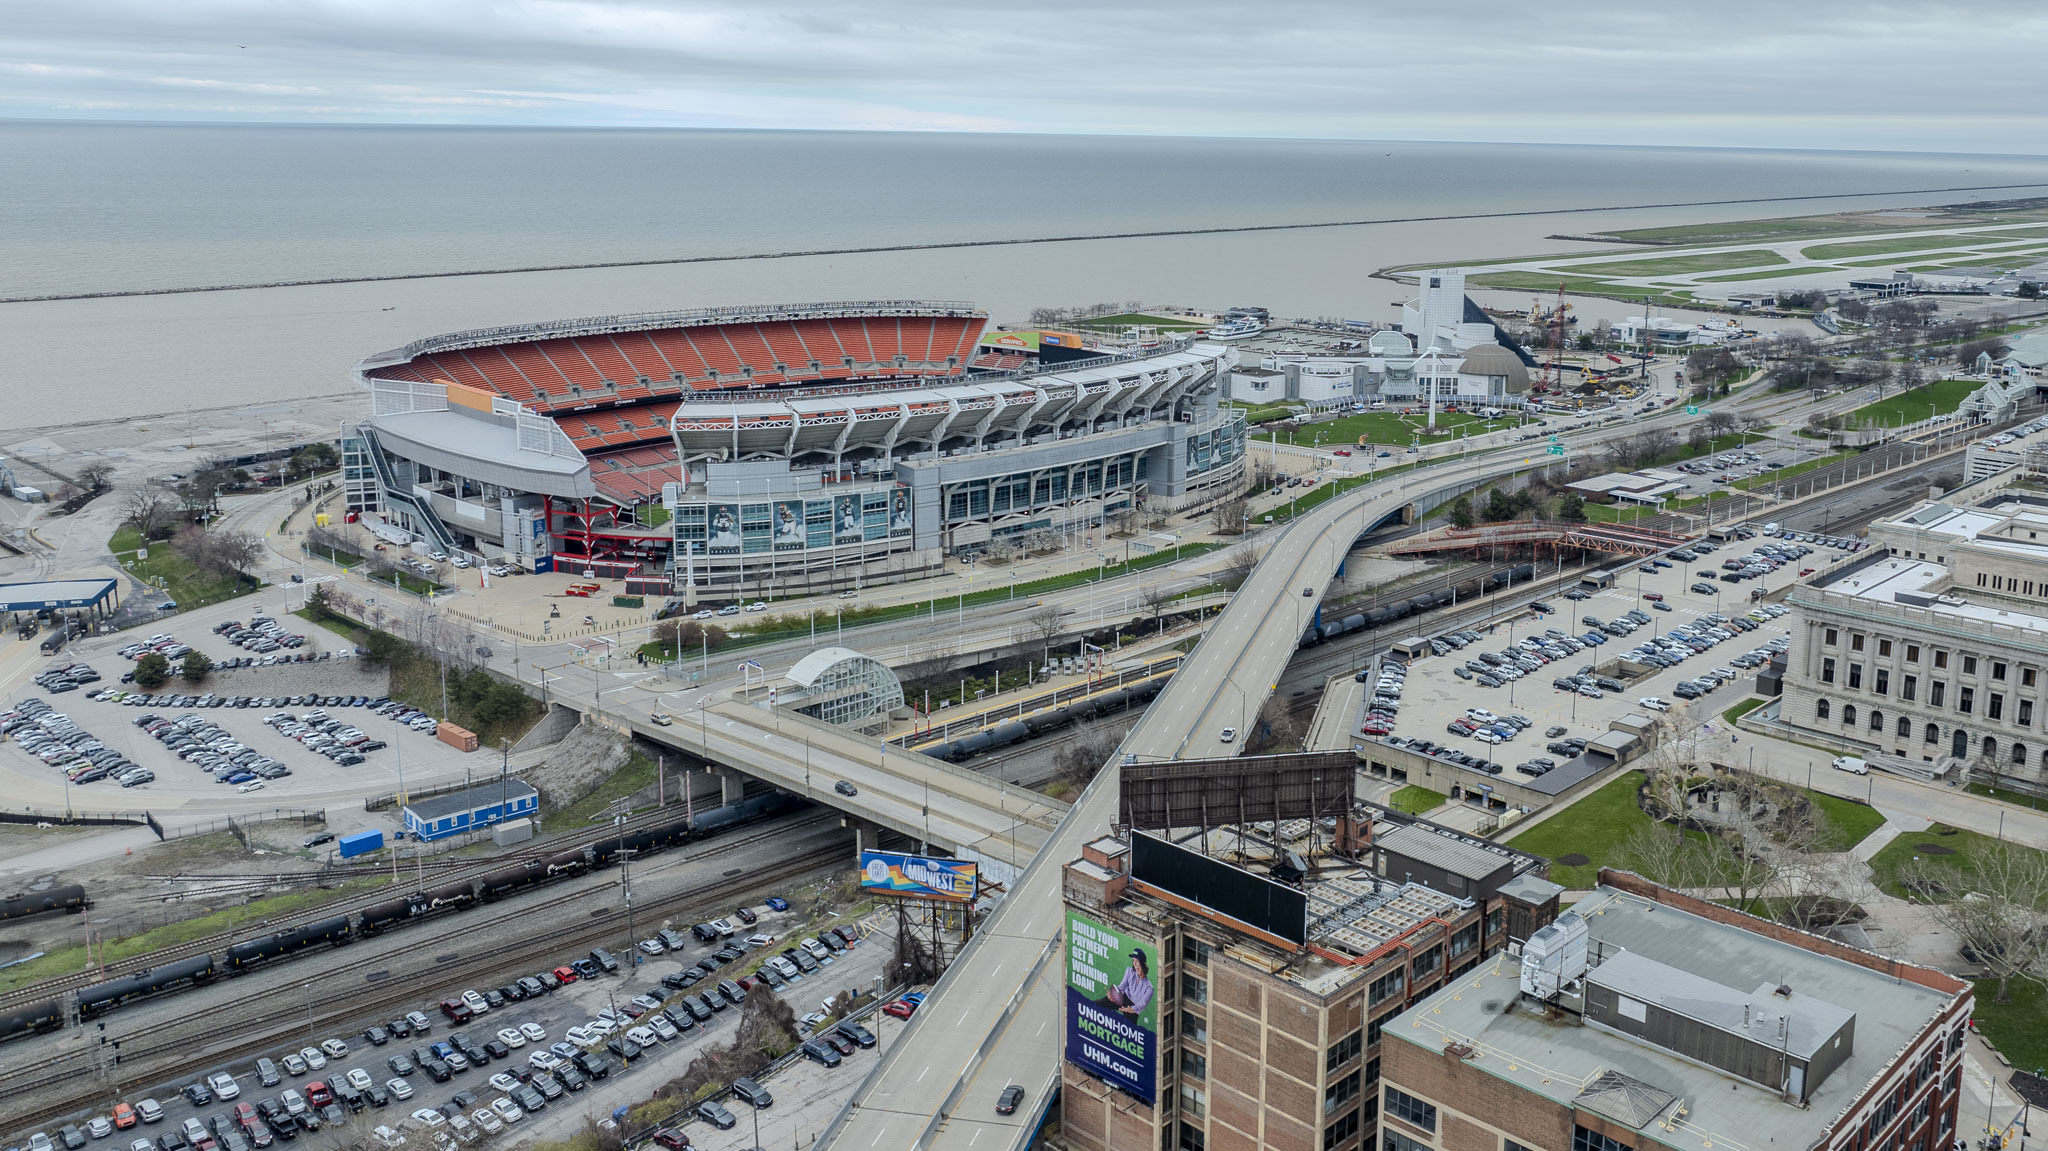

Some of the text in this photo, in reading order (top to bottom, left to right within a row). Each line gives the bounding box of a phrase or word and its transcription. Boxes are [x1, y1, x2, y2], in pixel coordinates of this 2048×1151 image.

[908, 864, 927, 882] MID
[927, 871, 954, 891] WEST
[1072, 919, 1119, 951] BUILD YOUR
[1072, 932, 1110, 960] PAYMENT.
[1072, 945, 1094, 966] GET A
[1072, 958, 1108, 986] WINNING
[1072, 971, 1095, 993] LOAN!
[1078, 1003, 1144, 1045] UNIONHOME
[1078, 1016, 1144, 1060] MORTGAGE
[1083, 1043, 1138, 1082] UHM.com
